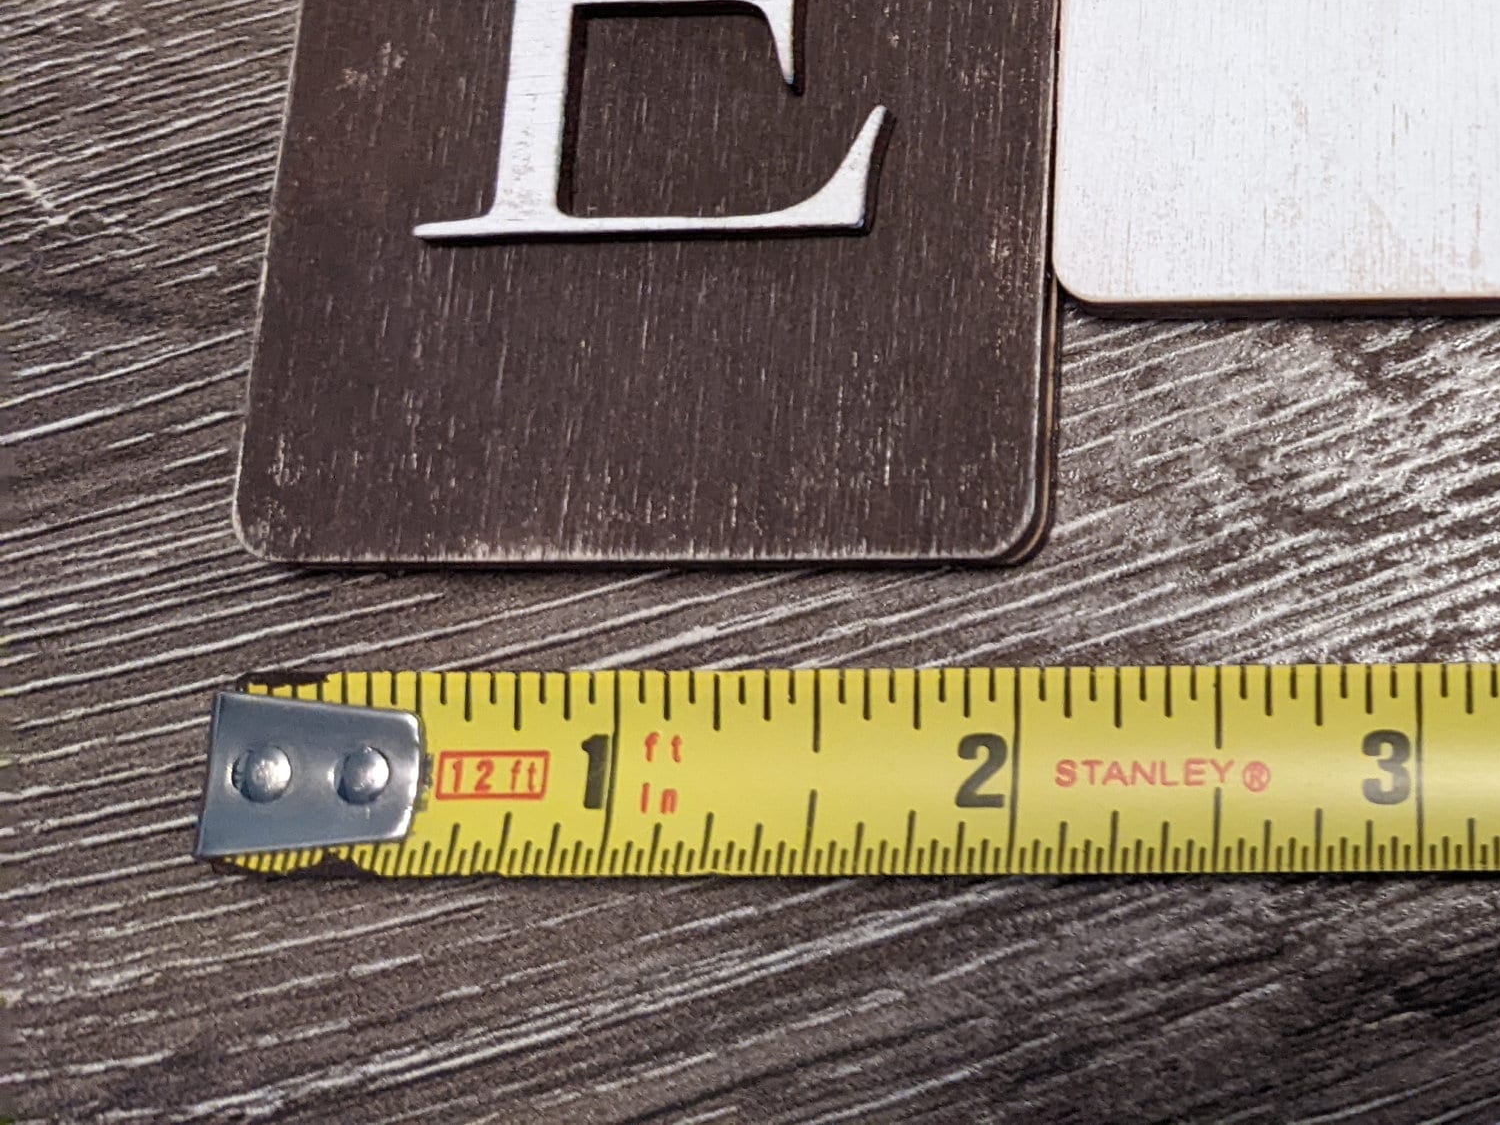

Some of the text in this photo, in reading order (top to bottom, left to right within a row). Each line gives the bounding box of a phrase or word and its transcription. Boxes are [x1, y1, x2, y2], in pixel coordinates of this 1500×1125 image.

[581, 734, 609, 810] 1
[955, 733, 1010, 808] 2
[1361, 729, 1412, 805] 3
